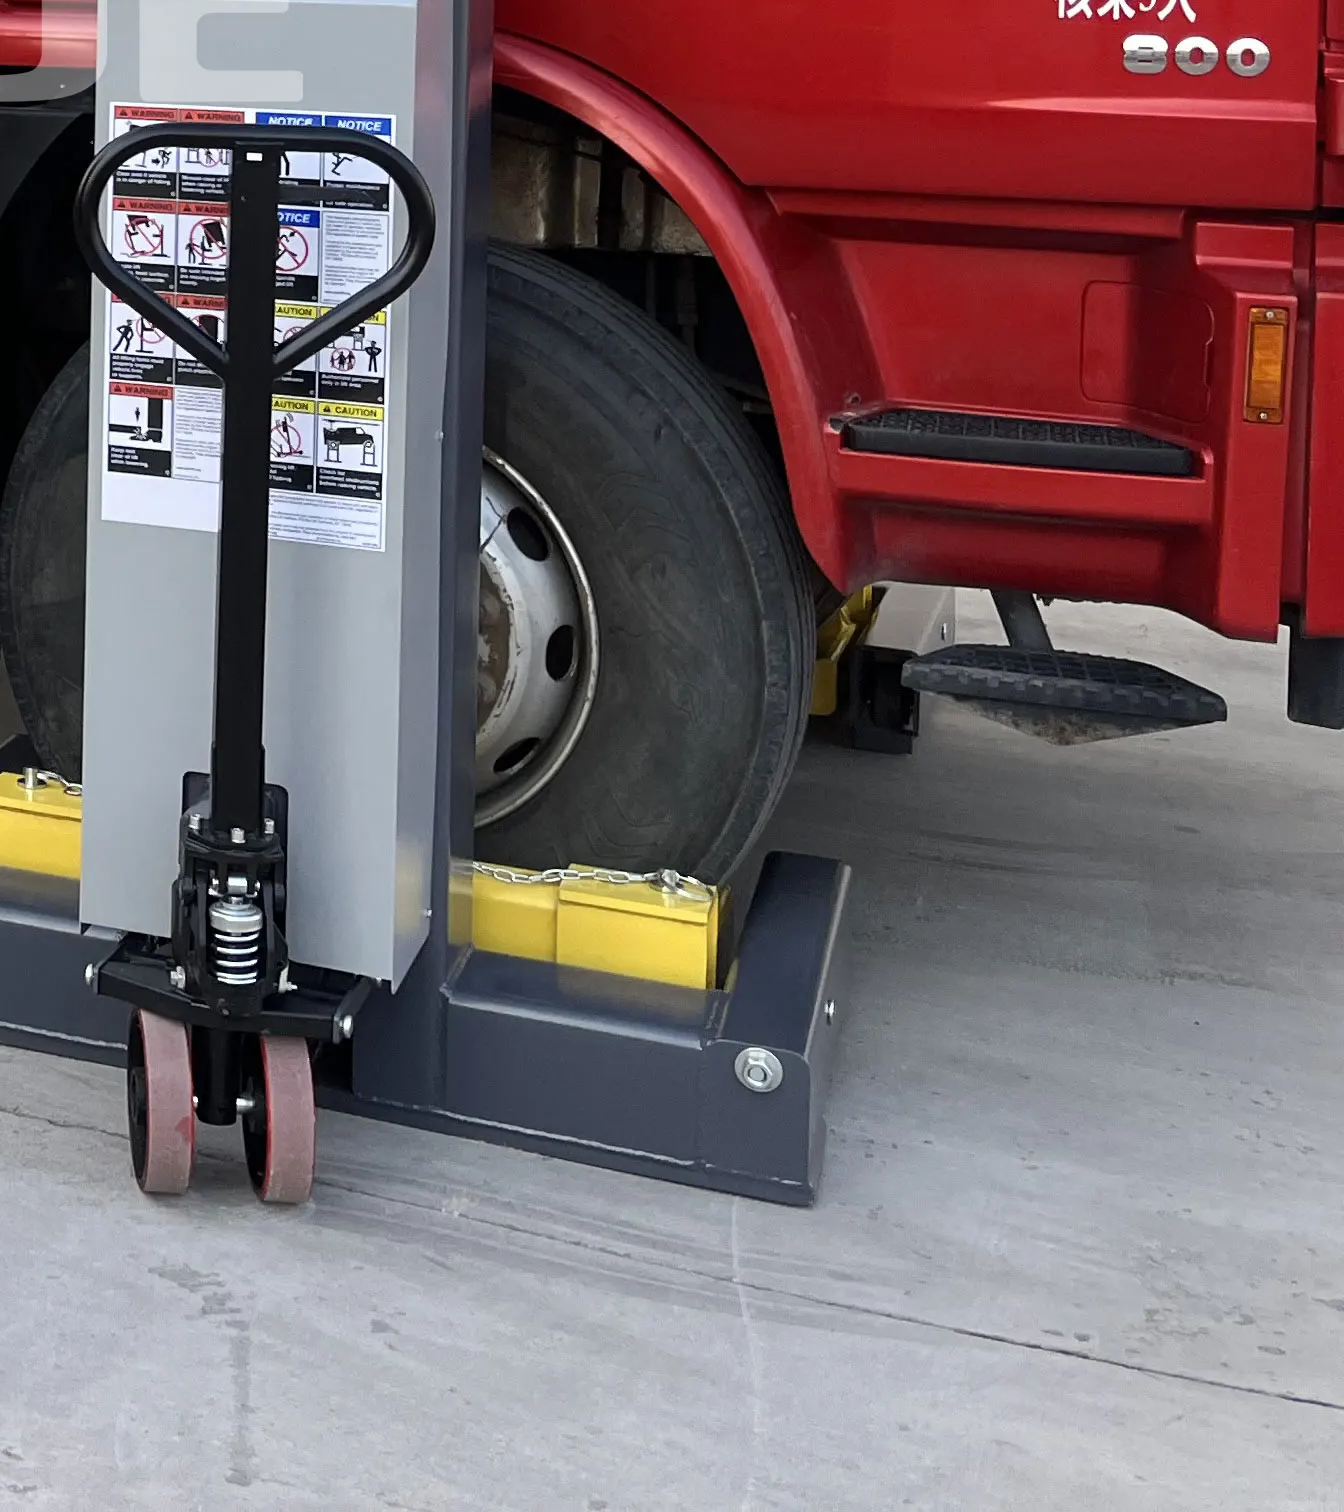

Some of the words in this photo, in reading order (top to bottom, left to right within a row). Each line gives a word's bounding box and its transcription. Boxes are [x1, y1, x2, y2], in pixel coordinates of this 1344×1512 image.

[1122, 34, 1271, 77] 800
[268, 116, 313, 126] NOTICE
[337, 120, 382, 132] NOTICE
[278, 212, 311, 223] OTICE
[276, 306, 312, 316] AUTION
[273, 400, 309, 411] AUTION
[335, 406, 377, 417] CAUTION
